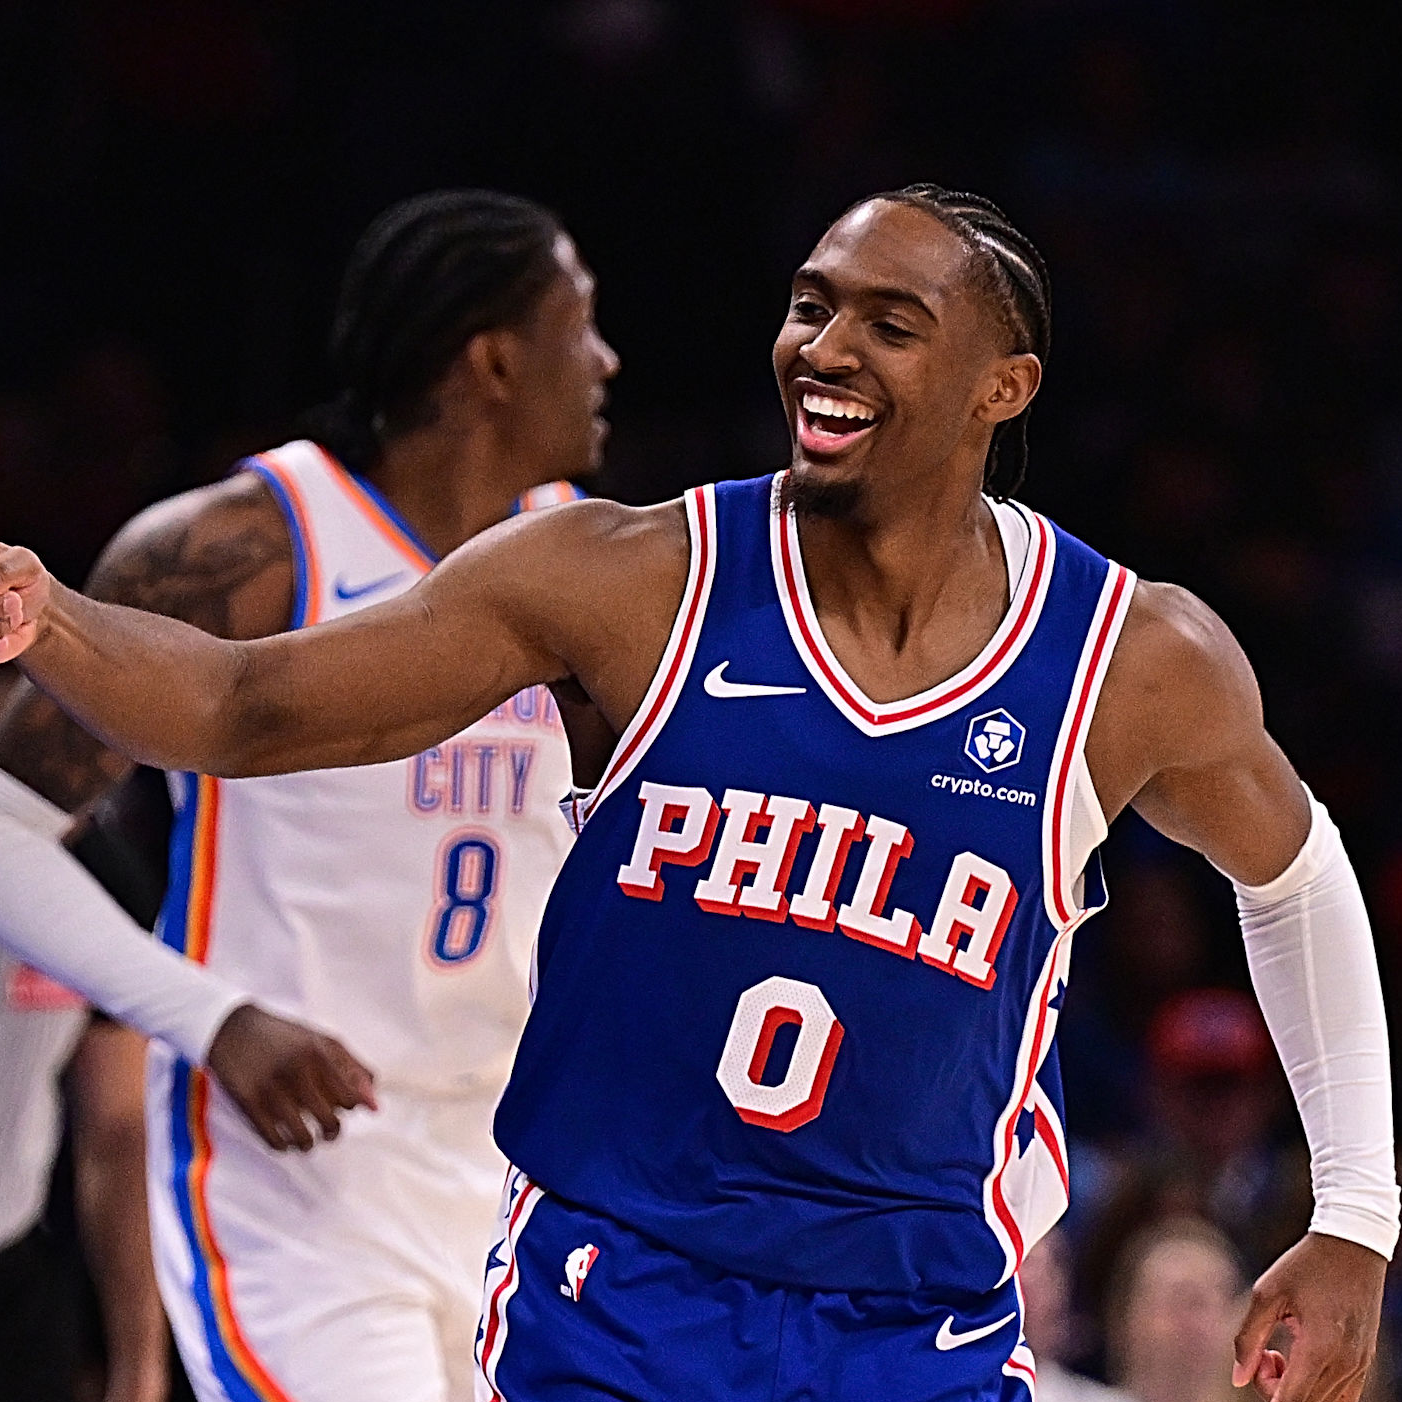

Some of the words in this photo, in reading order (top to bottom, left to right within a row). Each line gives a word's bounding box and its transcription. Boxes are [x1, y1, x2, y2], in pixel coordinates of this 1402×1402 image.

[409, 739, 537, 818] CITY
[930, 774, 1036, 807] crypto.com
[424, 828, 505, 973] 8
[617, 781, 1019, 991] PHILA
[716, 976, 845, 1133] 0
